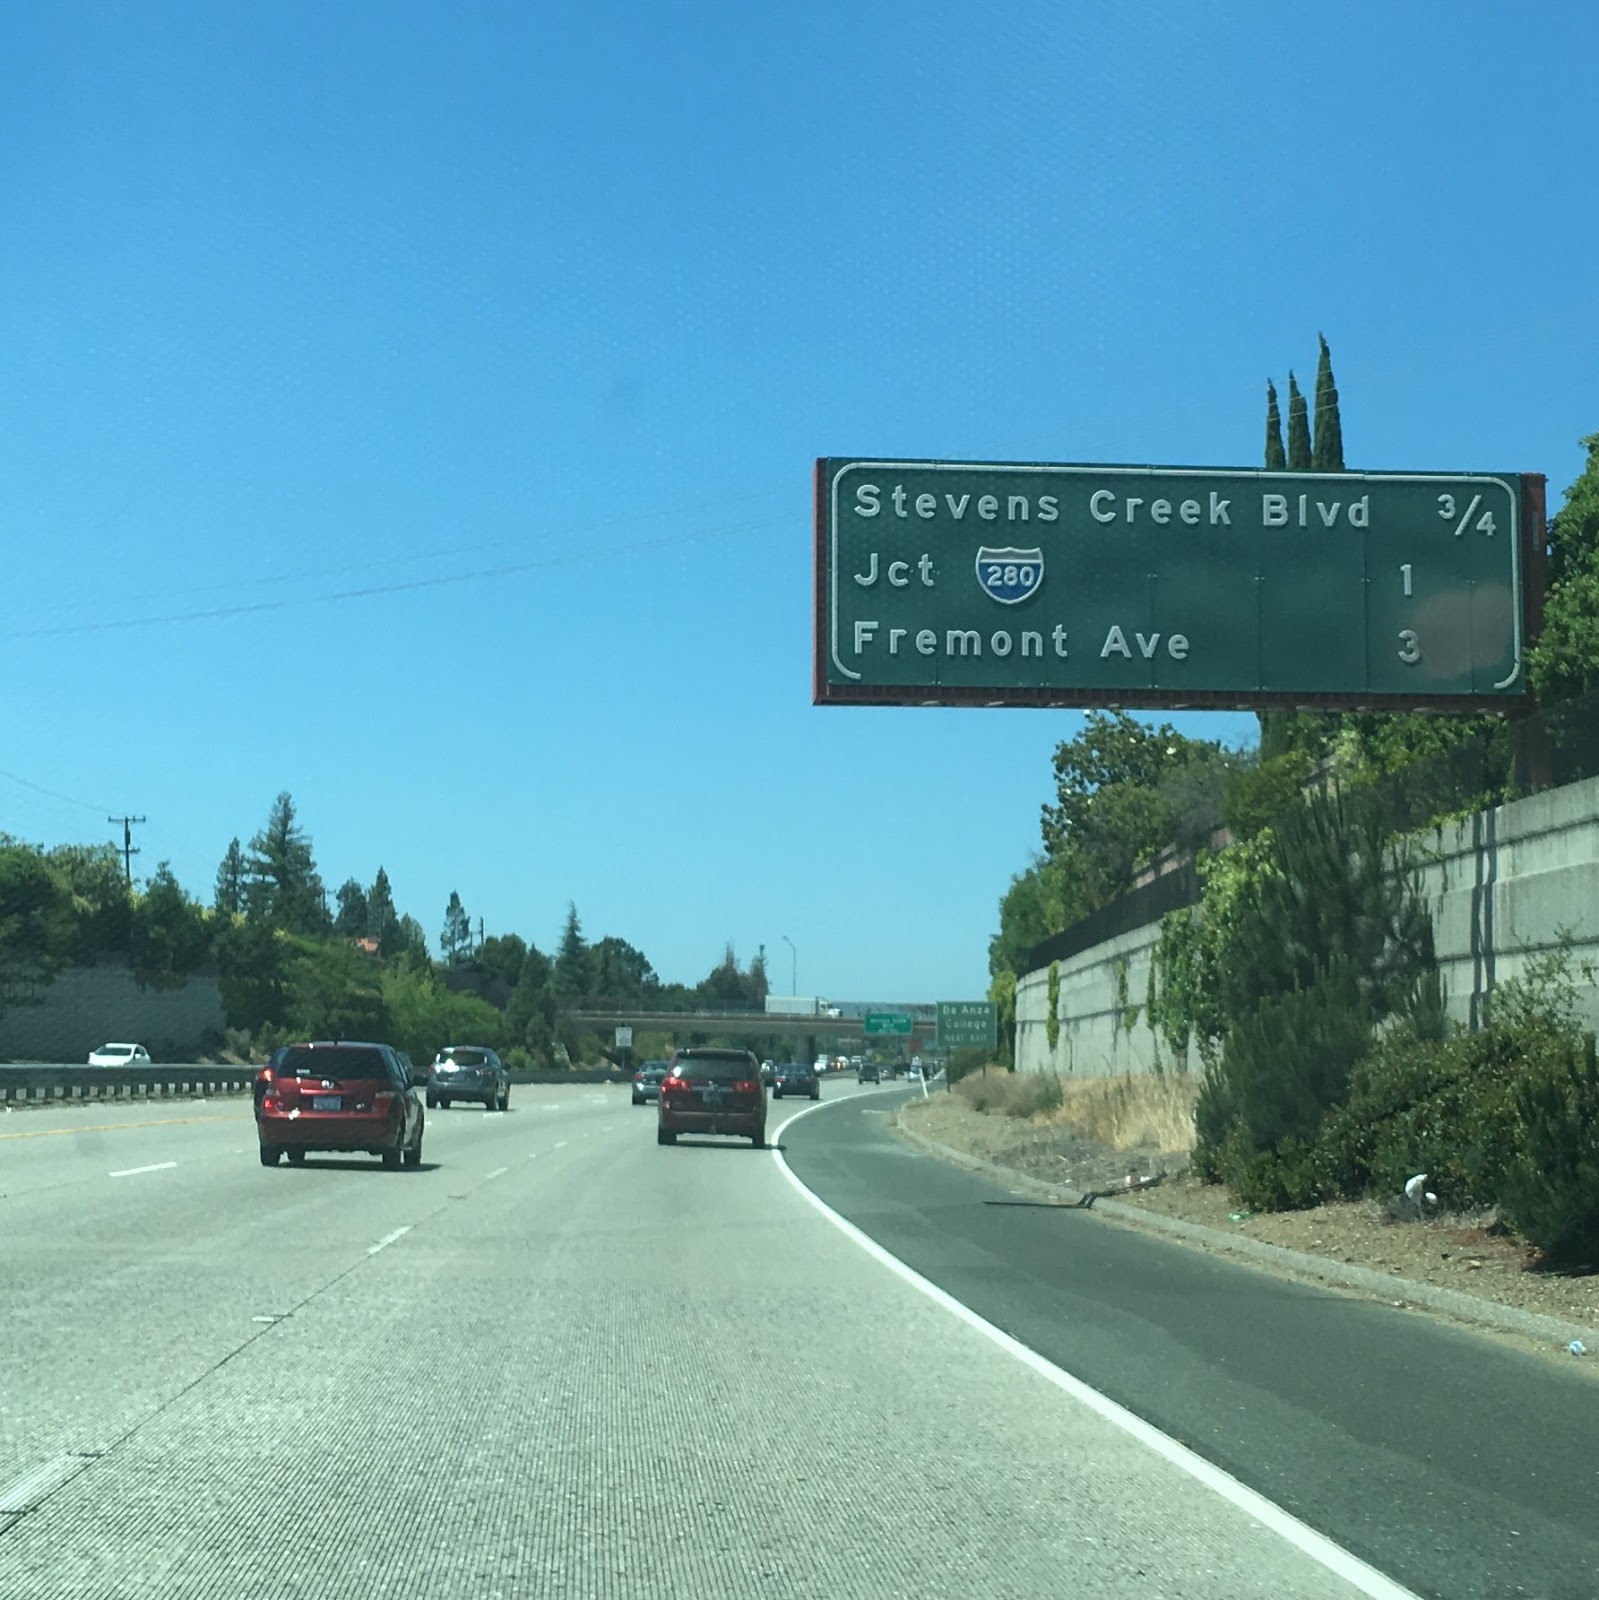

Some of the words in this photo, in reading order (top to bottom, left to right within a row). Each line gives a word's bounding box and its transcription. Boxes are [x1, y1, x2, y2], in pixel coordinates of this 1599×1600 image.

[853, 484, 1060, 522] Stevens
[1089, 489, 1232, 526] Creek
[1262, 493, 1370, 528] Blvd
[853, 552, 936, 587] Jct
[986, 565, 1035, 588] 280
[1399, 563, 1413, 597] 1
[853, 621, 1068, 658] Fremont
[1100, 625, 1190, 660] Ave
[1397, 629, 1421, 664] 3
[961, 1005, 990, 1014] Anza
